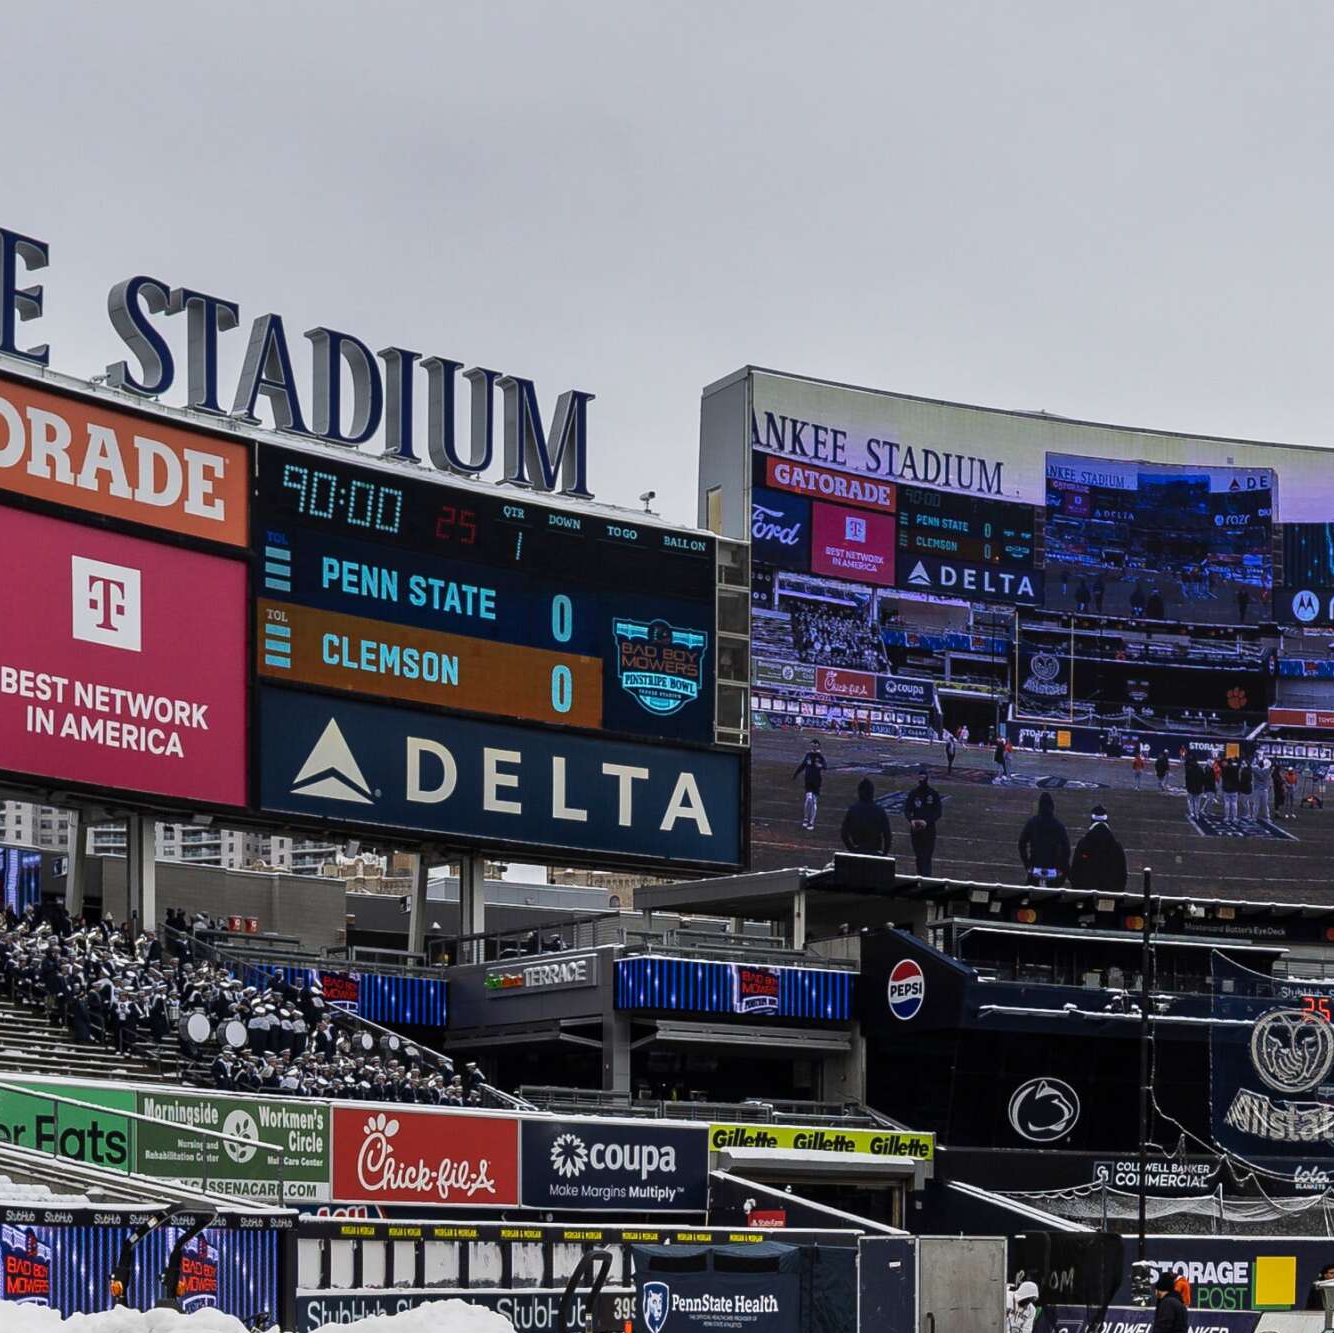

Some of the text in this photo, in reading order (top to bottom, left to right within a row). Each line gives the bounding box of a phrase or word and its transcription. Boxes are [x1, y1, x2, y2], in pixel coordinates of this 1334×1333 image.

[107, 275, 595, 499] STADIUM
[866, 438, 1003, 495] STADIUM
[774, 463, 891, 507] GATORADE
[502, 505, 525, 520] QTR
[548, 514, 581, 531] DOWN
[916, 514, 969, 532] PENN STATE
[435, 505, 477, 545] 25
[266, 531, 289, 545] TOL
[664, 535, 707, 552] BALL ON
[916, 536, 958, 552] CLEMSON
[940, 567, 1035, 597] DELTA
[322, 556, 573, 643] PENN STATE 0
[265, 608, 289, 623] TOL
[622, 641, 699, 663] BAD BOY
[322, 632, 573, 714] CLEMSON 0
[622, 655, 699, 677] MOWERS
[0, 666, 209, 731] BEST NETWORK
[26, 703, 185, 759] IN AMERICA
[405, 736, 714, 837] DELTA
[523, 960, 587, 988] TERRACE
[890, 982, 923, 998] PEPSI
[144, 1098, 219, 1125] Morningside
[259, 1106, 324, 1130] Workmen's
[35, 1115, 127, 1164] Eats
[288, 1130, 323, 1153] Circle
[713, 1128, 929, 1156] Gillette Gillette Gillette
[145, 1150, 194, 1162] Rehabilitation
[284, 1157, 323, 1167] Care Center
[357, 1130, 496, 1197] Chick-fil-A
[590, 1143, 676, 1180] coupa
[1116, 1162, 1210, 1174] COLWELL BANKER
[549, 1184, 578, 1197] Make
[581, 1185, 626, 1201] Margins
[6, 1256, 31, 1275] BAD
[181, 1257, 202, 1275] BAD
[734, 1294, 779, 1313] Health
[1198, 1287, 1247, 1310] POST
